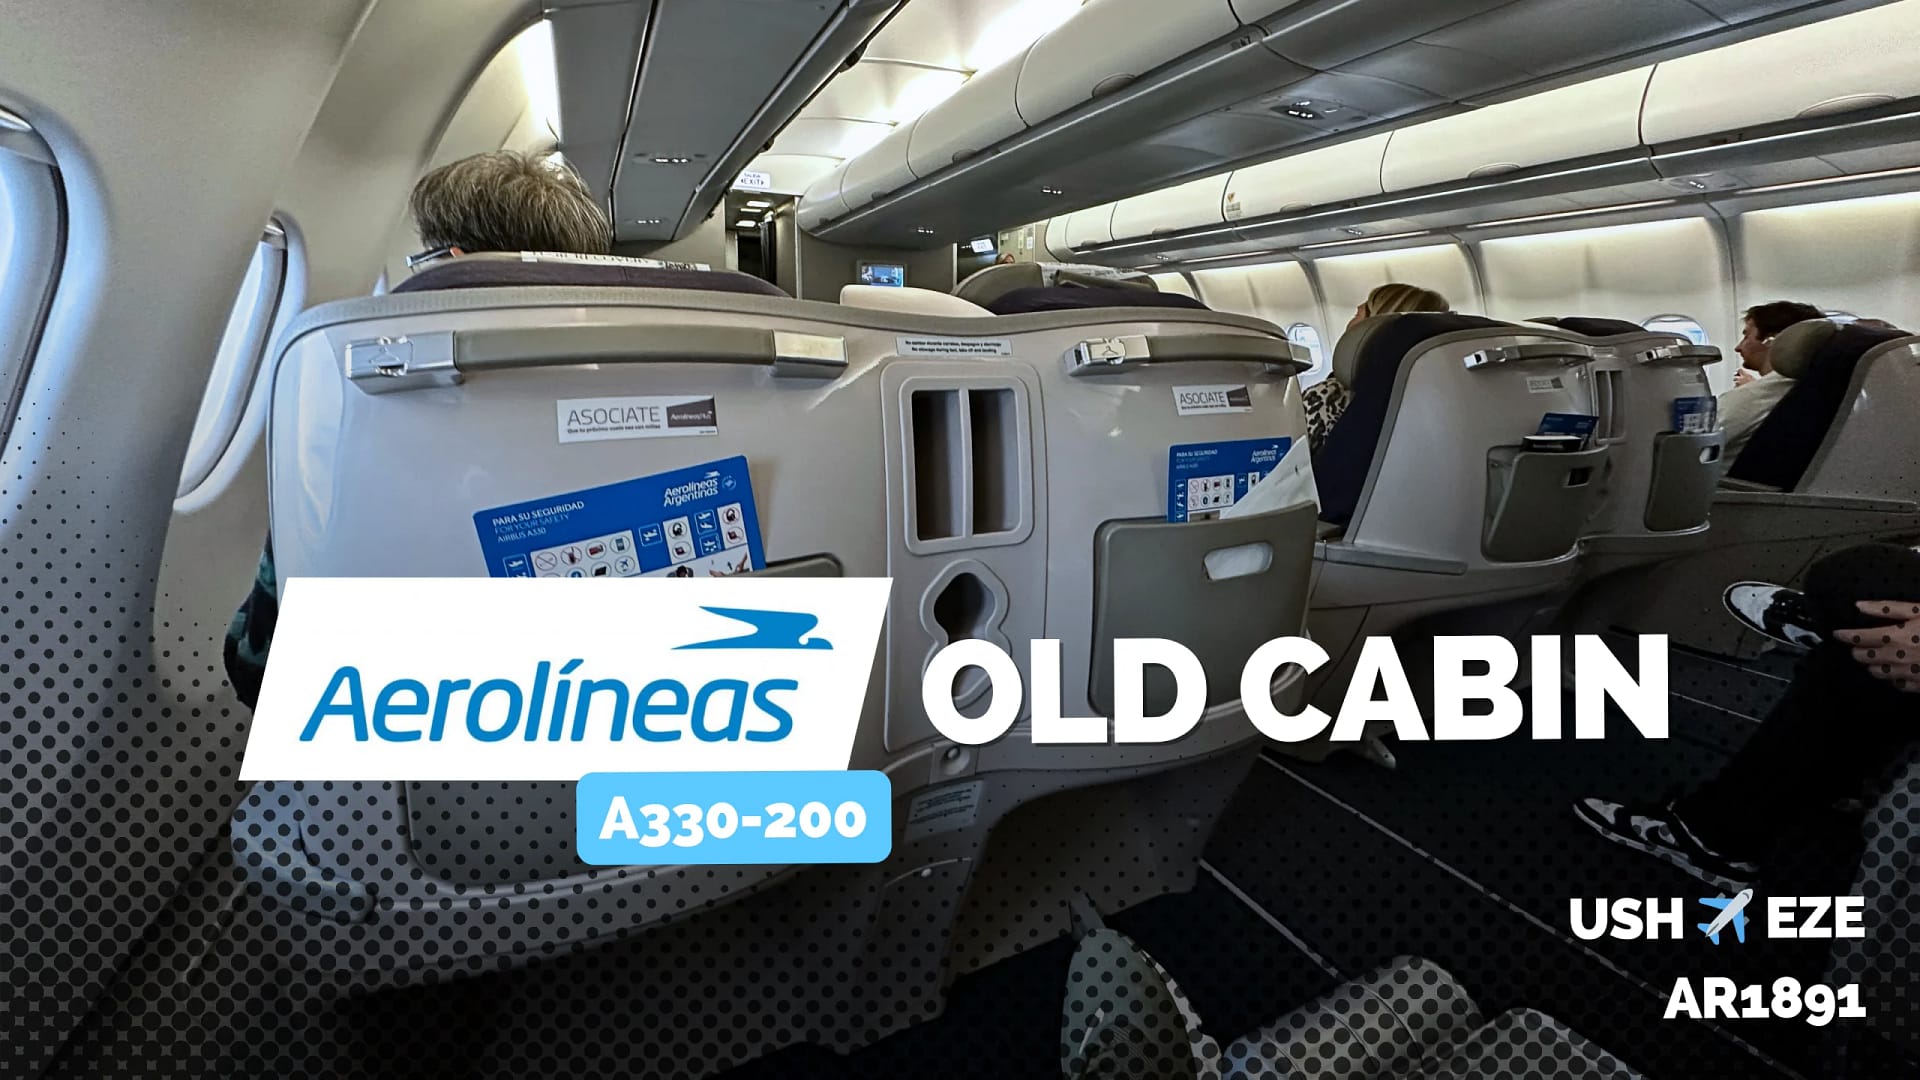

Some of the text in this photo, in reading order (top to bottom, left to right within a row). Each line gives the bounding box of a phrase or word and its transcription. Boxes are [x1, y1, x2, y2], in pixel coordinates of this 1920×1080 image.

[1180, 391, 1225, 404] ASOCIATE
[567, 405, 661, 426] ASOCIATE
[664, 487, 719, 507] Argentinas
[492, 501, 585, 527] PARA SU SEGURIDAD
[494, 513, 569, 534] FOR YOUR SAFETY
[498, 531, 526, 543] AIRBUS
